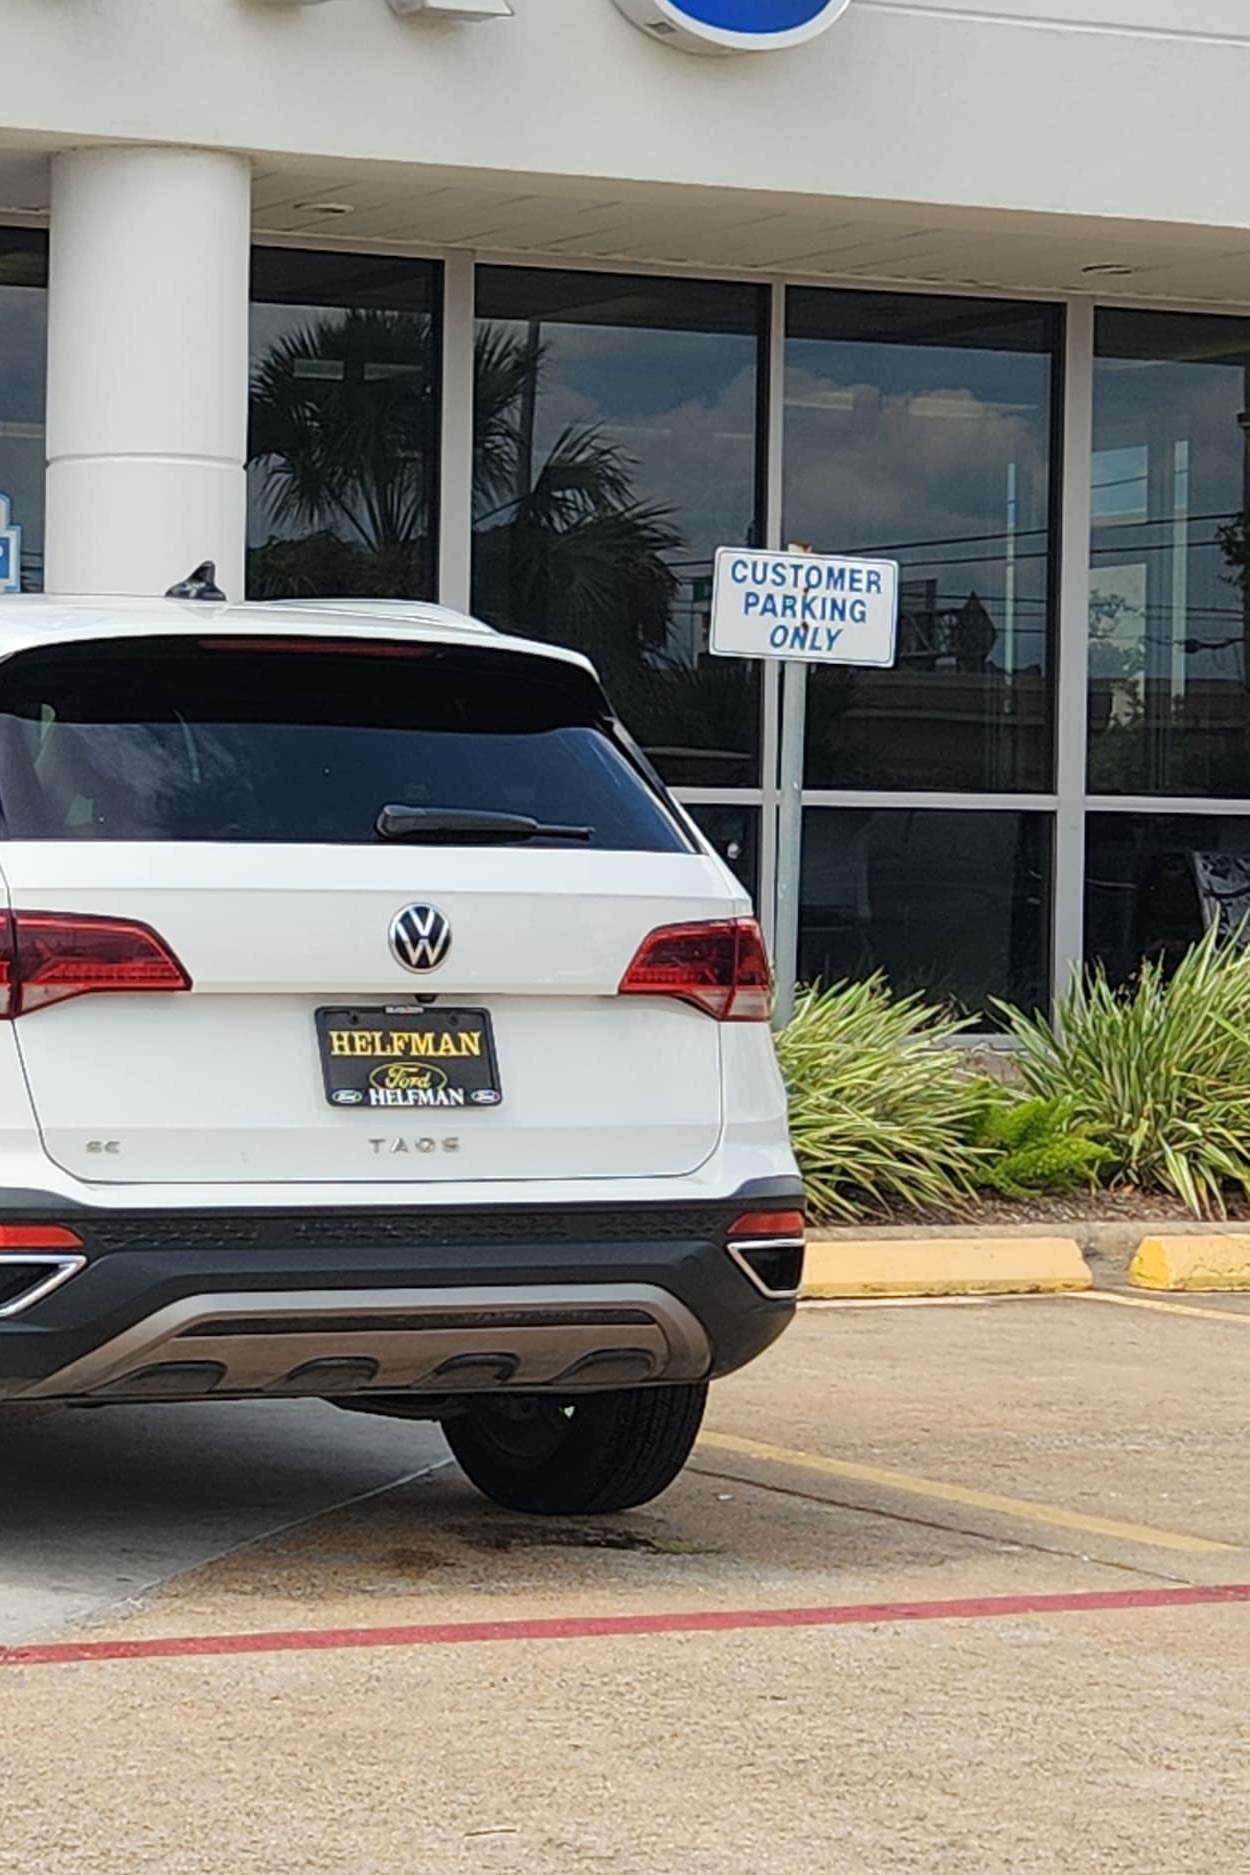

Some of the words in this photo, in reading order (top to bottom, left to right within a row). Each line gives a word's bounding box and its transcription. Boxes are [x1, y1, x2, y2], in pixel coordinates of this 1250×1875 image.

[730, 559, 882, 594] CUSTOMER
[743, 591, 867, 624] PARKING
[769, 624, 844, 652] ONLY
[328, 1030, 483, 1057] HELFMAN
[384, 1066, 432, 1089] Ford
[369, 1087, 466, 1106] HELFMAN
[367, 1135, 460, 1154] TAOS
